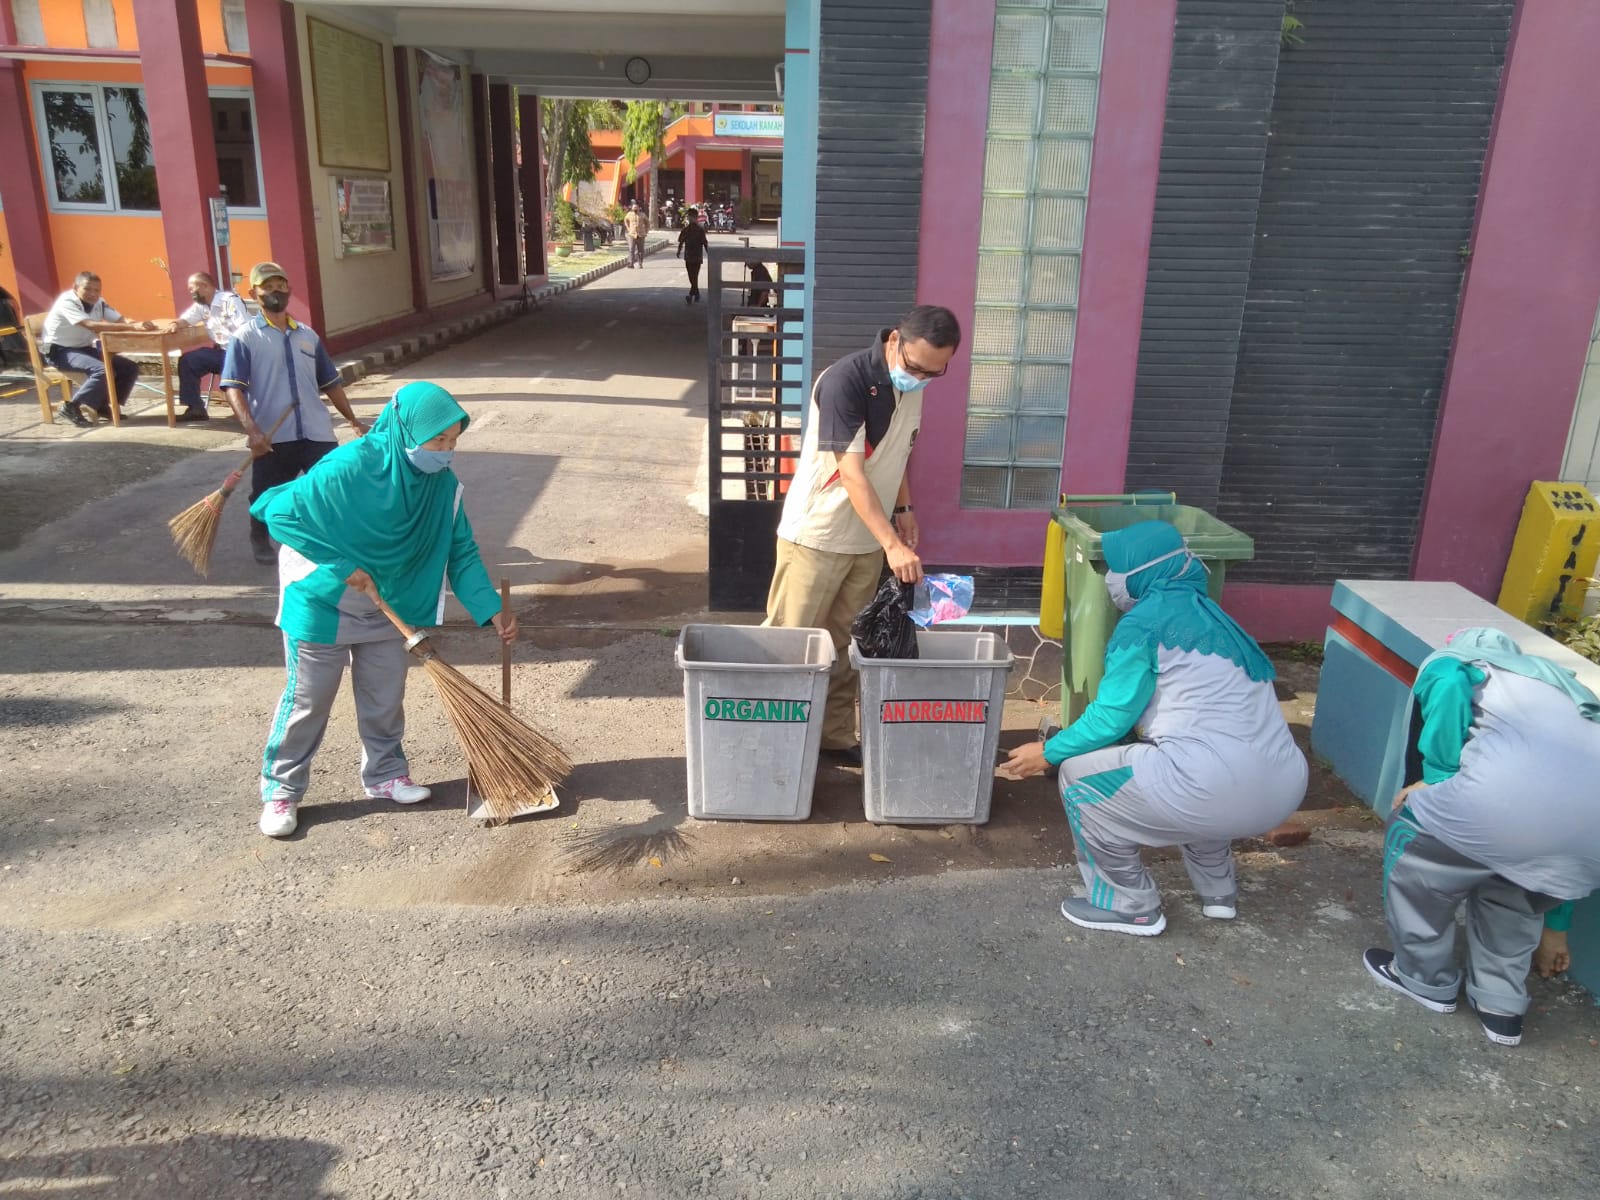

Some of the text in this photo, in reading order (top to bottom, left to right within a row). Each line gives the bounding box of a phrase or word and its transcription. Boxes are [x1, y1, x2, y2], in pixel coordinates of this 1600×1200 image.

[730, 119, 783, 131] SEKOLAH RAMAH
[704, 699, 808, 721] ORGANIK
[883, 701, 985, 721] AN ORGANIK
